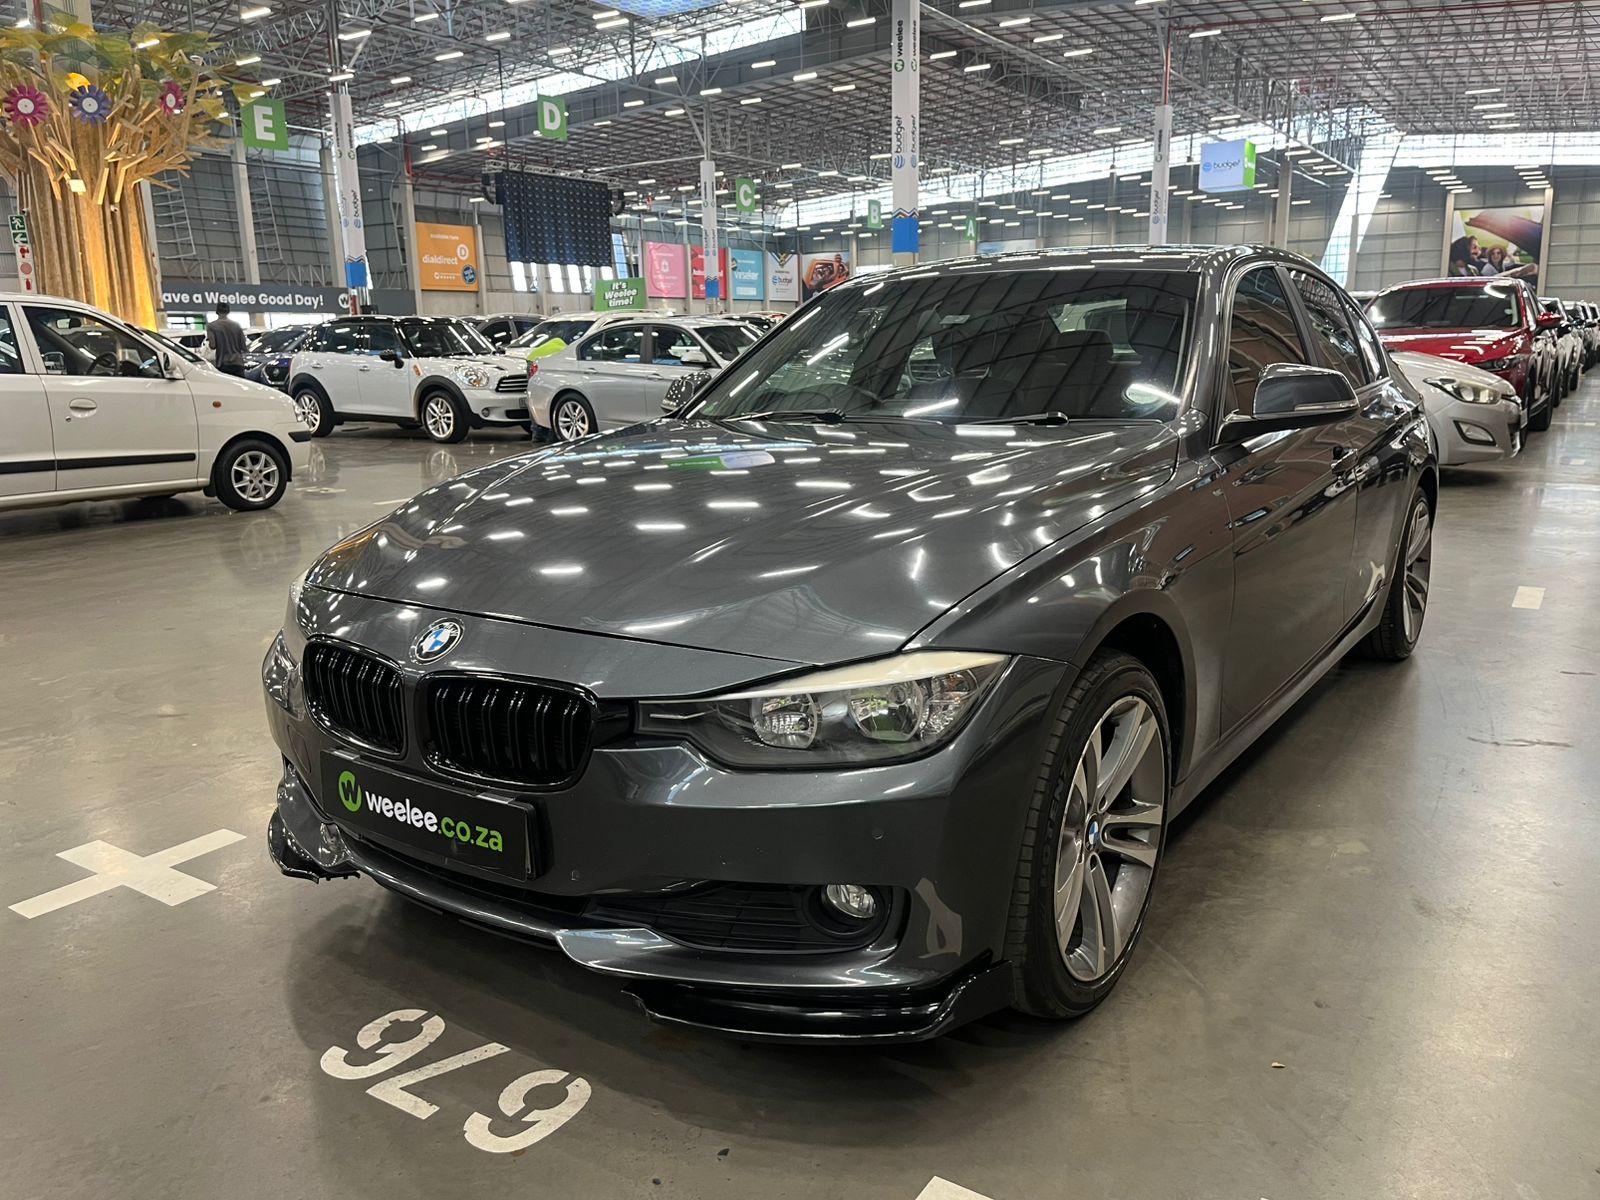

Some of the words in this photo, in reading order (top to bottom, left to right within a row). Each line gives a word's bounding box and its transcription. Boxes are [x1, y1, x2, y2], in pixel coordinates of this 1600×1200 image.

[253, 105, 276, 141] E
[543, 101, 561, 130] D
[894, 115, 905, 153] budget
[1213, 160, 1240, 170] budget
[739, 183, 752, 207] C
[870, 204, 880, 224] B
[967, 220, 975, 237] A
[422, 254, 459, 265] dialdirect
[604, 288, 638, 300] Weelee
[612, 282, 627, 290] It's
[162, 292, 190, 303] ave
[192, 293, 203, 304] a
[205, 291, 256, 304] Weelee
[258, 293, 293, 305] Good
[295, 294, 324, 310] Day!
[608, 296, 633, 307] time!
[365, 790, 503, 852] weelee.co.za
